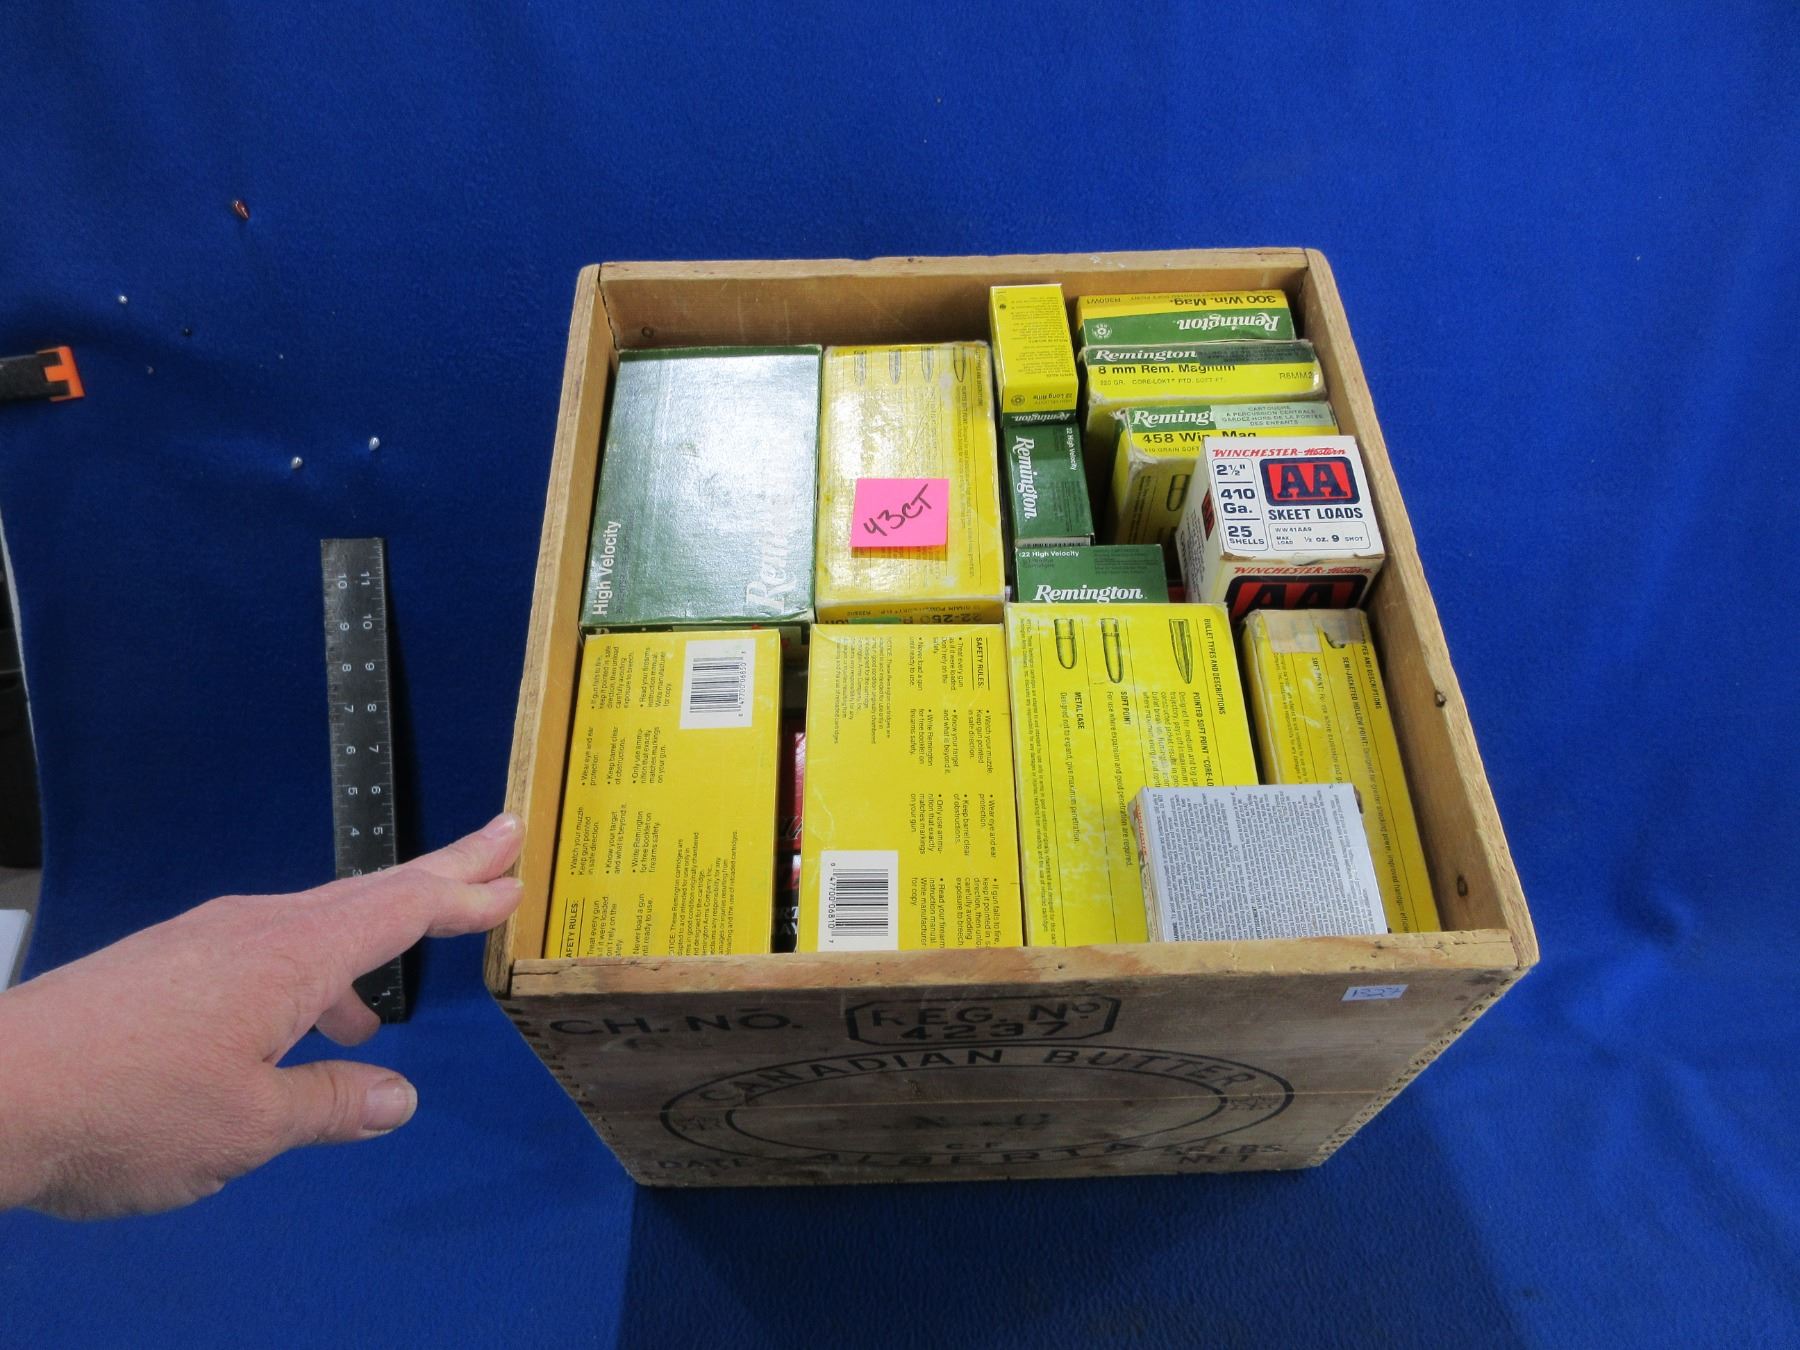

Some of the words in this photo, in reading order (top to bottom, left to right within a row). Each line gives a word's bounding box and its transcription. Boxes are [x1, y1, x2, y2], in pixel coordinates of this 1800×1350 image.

[1170, 297, 1207, 305] Mag.
[1211, 296, 1242, 304] Win.
[1246, 295, 1275, 303] 300
[1176, 313, 1280, 331] Remington
[1095, 350, 1198, 361] Remington
[1098, 366, 1106, 374] 8
[1112, 366, 1136, 374] mm
[1141, 365, 1174, 373] Rem.
[1143, 434, 1173, 443] 458
[1013, 436, 1038, 519] Remington
[1277, 464, 1347, 498] AA
[1221, 489, 1255, 499] 410
[1223, 503, 1252, 514] Ga.
[1269, 509, 1310, 520] SKEET
[1317, 508, 1363, 519] LOADS
[1228, 526, 1252, 538] 25
[602, 521, 621, 577] Velocity
[338, 573, 347, 590] 10
[361, 571, 370, 586] 11
[592, 580, 613, 615] High
[1033, 585, 1143, 603] Remington
[340, 622, 349, 631] 9
[363, 614, 373, 630] 10
[1204, 619, 1213, 639] BULLET
[1206, 641, 1215, 659] TYPES
[342, 664, 351, 672] 8
[365, 663, 374, 671] 9
[1210, 660, 1218, 672] AND
[1120, 692, 1128, 706] SOFT
[1212, 673, 1225, 715] DESCRIPTIONS
[344, 705, 354, 713] 7
[367, 704, 377, 712] 8
[1074, 692, 1083, 714] METAL
[1192, 692, 1202, 718] POINTED
[1076, 714, 1085, 730] CASE
[1122, 707, 1131, 725] POINT
[1196, 719, 1204, 735] SOFT
[347, 746, 355, 754] 6
[369, 745, 379, 753] 7
[1199, 736, 1209, 754] POINT
[348, 787, 358, 795] 5
[372, 786, 381, 794] 6
[919, 793, 927, 825] matches
[1351, 701, 1363, 725] HOLLOW
[1400, 912, 1410, 933] efficien
[351, 828, 360, 837] 4
[374, 827, 383, 835] 5
[919, 826, 927, 855] markings
[927, 828, 936, 852] exactly
[911, 878, 919, 887] for
[920, 878, 928, 897] Write
[981, 878, 990, 893] keep
[929, 878, 938, 914] instruction
[938, 884, 946, 903] Read
[956, 878, 964, 910] exposure
[964, 878, 973, 908] carefully
[991, 892, 999, 905] gun
[568, 901, 579, 930] RULES:
[937, 905, 945, 921] your
[974, 912, 982, 928] then
[983, 901, 991, 929] pointed
[992, 906, 1000, 920] fails
[920, 898, 928, 946] manufacturer
[965, 909, 974, 940] avoiding
[993, 922, 1000, 930] to
[939, 922, 947, 948] firearm
[566, 932, 575, 958] AFETY
[550, 1018, 670, 1034] CH.
[901, 1021, 1069, 1040] 4237
[700, 1050, 1003, 1100] CANADIAN
[1043, 1050, 1257, 1087] BUTTER
